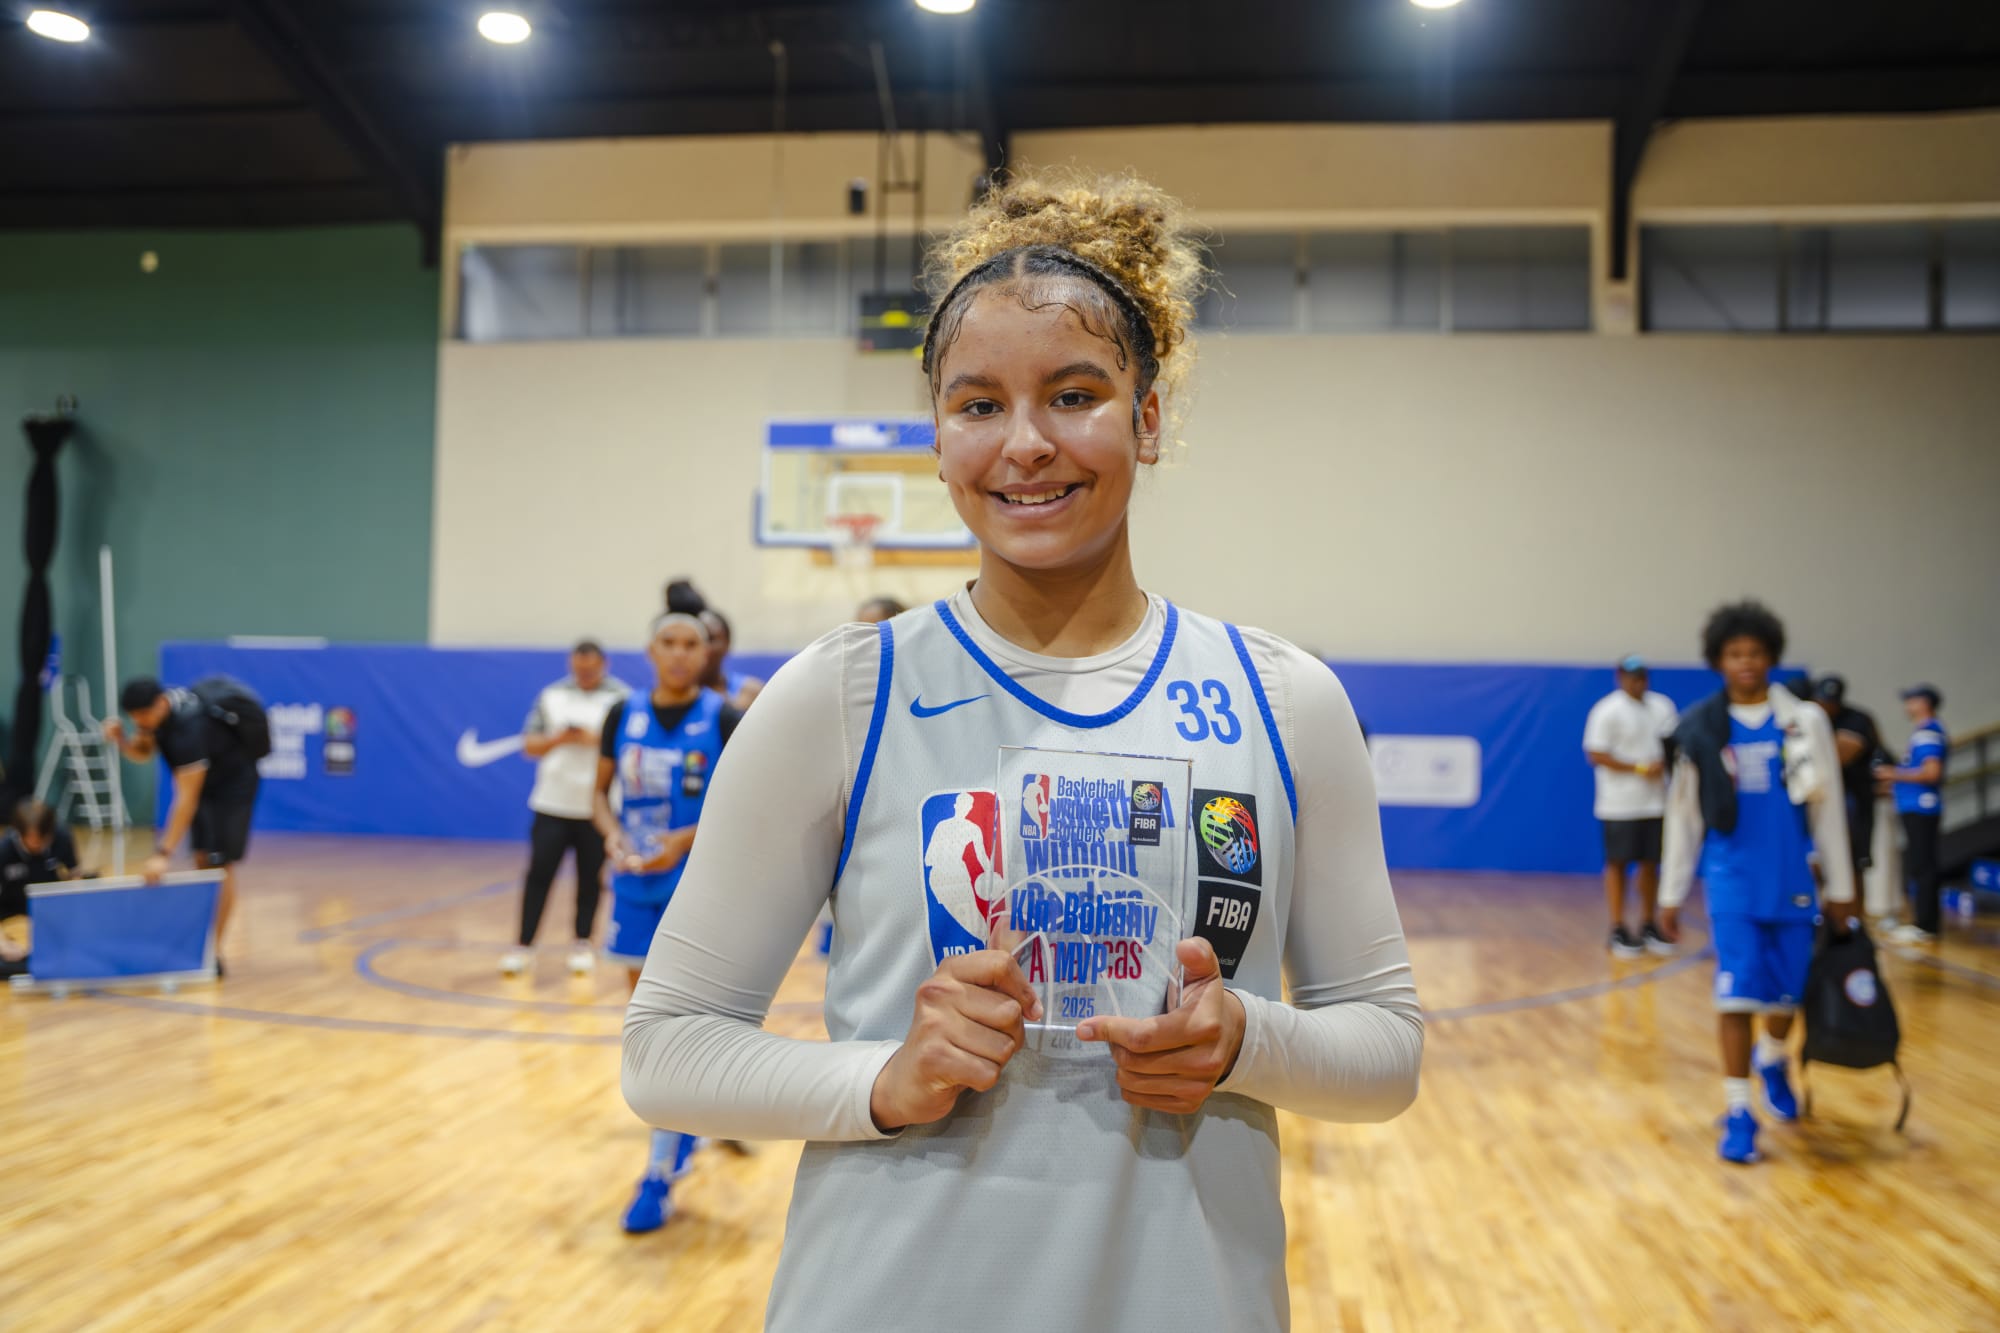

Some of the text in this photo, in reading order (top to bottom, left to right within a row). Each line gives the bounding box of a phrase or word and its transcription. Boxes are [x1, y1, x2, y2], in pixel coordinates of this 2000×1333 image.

[1167, 679, 1242, 744] 33
[1057, 775, 1125, 799] Basketball
[1022, 824, 1037, 837] NBA
[1056, 819, 1106, 843] Borders
[1134, 817, 1157, 830] FIBA
[1206, 896, 1252, 931] FIBA
[1054, 941, 1108, 984] MVP
[1062, 997, 1095, 1018] 2025
